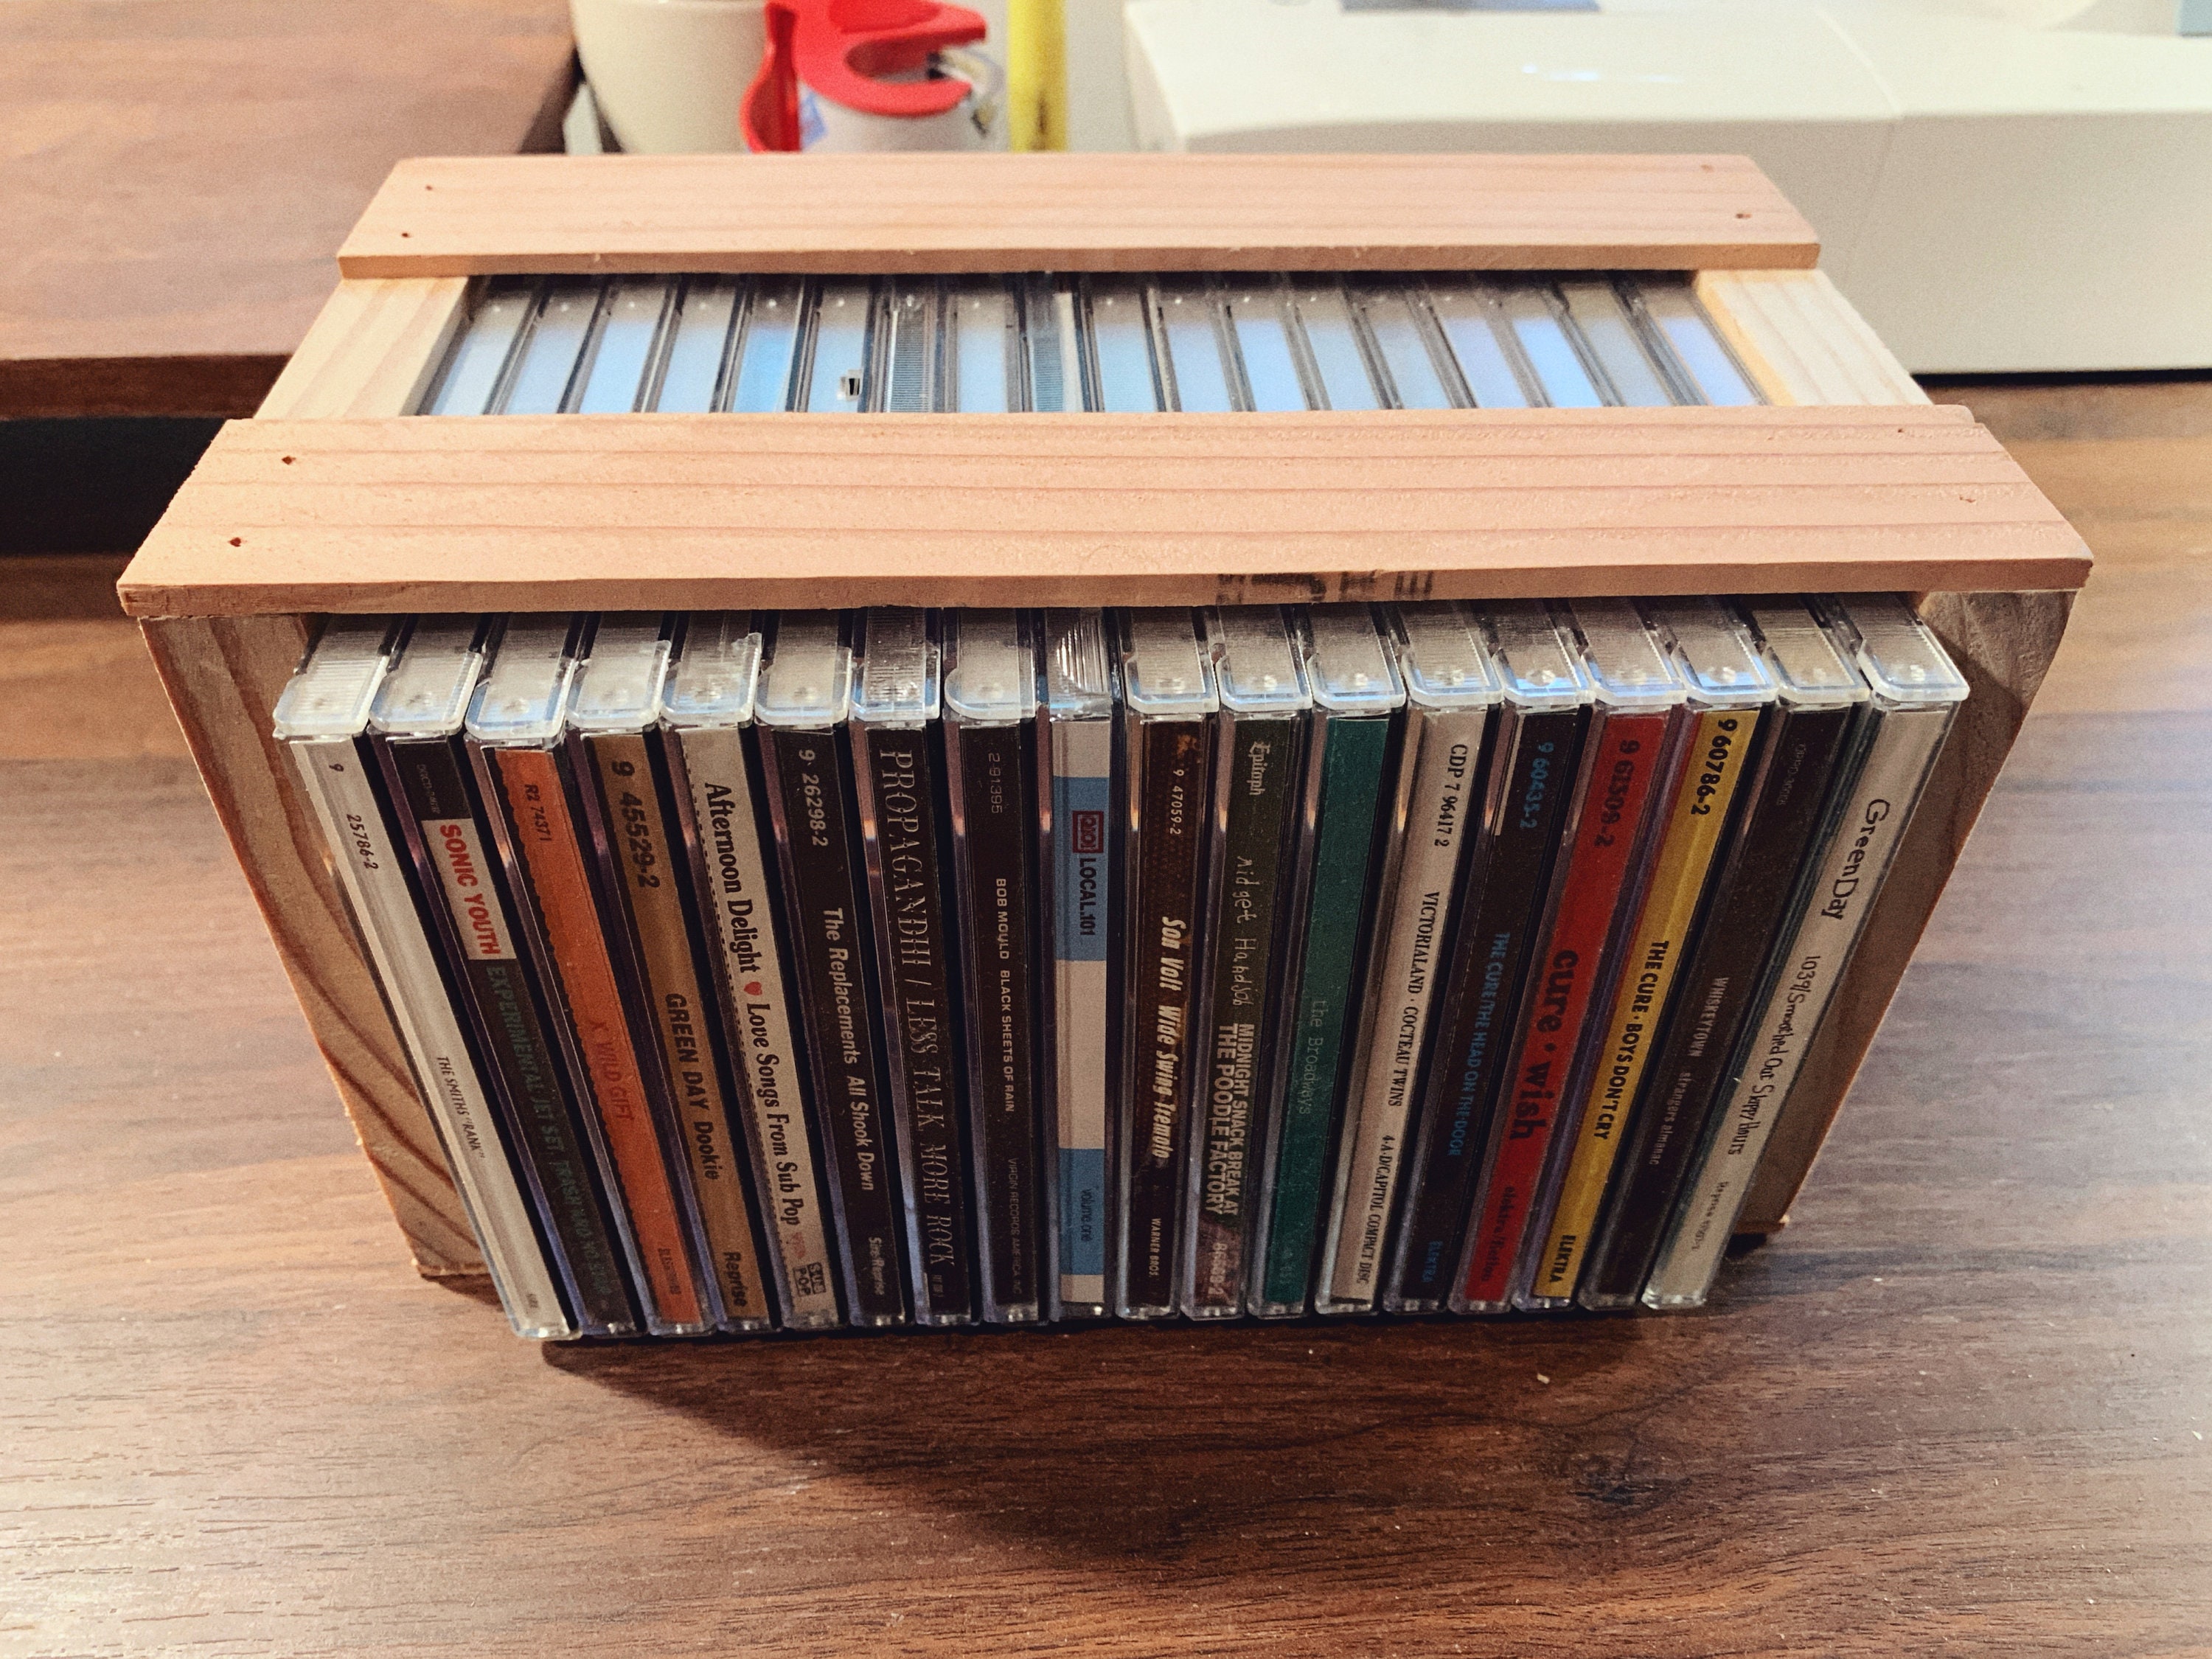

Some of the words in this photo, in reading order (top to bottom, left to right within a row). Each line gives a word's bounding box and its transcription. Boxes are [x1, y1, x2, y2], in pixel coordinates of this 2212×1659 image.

[1717, 718, 1738, 731] 9
[1447, 743, 1467, 779] CDP
[1536, 741, 1554, 753] 9
[1618, 739, 1641, 754] 9
[610, 759, 635, 776] 9
[1172, 768, 1185, 776] 9
[1246, 740, 1271, 796] Epitaph
[1443, 782, 1461, 791] 7
[1689, 734, 1731, 815] 60786-2
[524, 783, 540, 801] R2
[801, 773, 829, 846] 26298-2
[1168, 785, 1183, 835] 47059-2
[1518, 757, 1550, 829] 60435-2
[327, 762, 345, 772] 9
[345, 813, 379, 869] 25786-2
[529, 805, 552, 841] 74371
[1436, 795, 1458, 835] 96417
[618, 790, 661, 888] 45529-2
[703, 782, 742, 894] Afternoon
[879, 751, 932, 966] PROPAGANDHI
[1433, 838, 1450, 847] 2
[439, 824, 479, 887] SONIC
[463, 892, 501, 955] YOUTH
[995, 877, 1008, 907] BOB
[726, 898, 762, 973] Delight
[823, 907, 844, 941] The
[995, 910, 1010, 959] MOULD
[1161, 916, 1186, 950] Son
[1407, 891, 1440, 994] VICTORIALAND
[1489, 932, 1511, 959] THE
[1644, 940, 1669, 970] THE
[999, 969, 1012, 1012] BLACK
[1158, 956, 1184, 991] Volt
[1536, 948, 1579, 1033] cure
[1630, 972, 1658, 1012] CURE
[828, 947, 861, 1064] Replacements
[1308, 999, 1329, 1028] the
[1474, 961, 1503, 1028] CURE/THE
[585, 1017, 610, 1032] X
[664, 992, 699, 1062] GREEN
[745, 1002, 771, 1048] Love
[905, 999, 938, 1054] LESS
[1156, 1004, 1182, 1045] Wide
[1394, 1006, 1419, 1065] COCTEAU
[1688, 976, 1730, 1057] WHISKEYTOWN
[485, 965, 545, 1092] EXPERIMENTAL
[529, 1096, 555, 1120] JET
[1001, 1015, 1014, 1062] SHEETS
[1217, 1022, 1241, 1060] THE
[1466, 1031, 1488, 1068] HEAD
[1615, 1023, 1644, 1062] BOYS
[435, 1056, 454, 1075] THE
[592, 1040, 627, 1083] WILD
[754, 1052, 780, 1107] Songs
[1002, 1065, 1014, 1081] OF
[1152, 1049, 1179, 1096] Swing
[1229, 1022, 1255, 1098] MIDNIGHT
[1295, 1036, 1324, 1114] Broadways
[1758, 1057, 1784, 1080] Out
[444, 1077, 470, 1116] SMITHS
[680, 1071, 709, 1110] DAY
[846, 1075, 867, 1096] All
[1004, 1084, 1015, 1112] RAIN
[1208, 1063, 1238, 1136] POODLE
[1387, 1067, 1408, 1107] TWINS
[1460, 1070, 1480, 1092] ON
[1507, 1060, 1554, 1141] wish
[1601, 1065, 1630, 1111] DON'T
[1663, 1071, 1694, 1123] strangers
[606, 1084, 635, 1122] GIFT
[1738, 1084, 1775, 1121] Slappy
[765, 1113, 790, 1156] From
[849, 1101, 873, 1147] Shook
[1151, 1101, 1176, 1158] Tremolo
[1225, 1098, 1248, 1150] SNACK
[1447, 1119, 1468, 1155] DOOR
[1593, 1113, 1615, 1140] CRY
[1648, 1124, 1674, 1165] almanac
[1726, 1120, 1761, 1155] Hours
[692, 1120, 723, 1180] Dookie
[775, 1161, 801, 1193] Sub
[856, 1151, 875, 1191] Down
[919, 1142, 950, 1204] MORE
[1006, 1157, 1019, 1189] VIRGIN
[1205, 1140, 1231, 1214] FACTORY
[1221, 1150, 1243, 1197] BREAK
[778, 1197, 804, 1225] Pop
[1008, 1191, 1020, 1235] RECORDS
[1079, 1188, 1096, 1223] volume
[1220, 1197, 1238, 1215] AT
[925, 1214, 955, 1265] ROCK
[1079, 1222, 1093, 1242] one
[1149, 1217, 1161, 1253] WARNER
[1360, 1213, 1382, 1260] COMPACT
[722, 1251, 748, 1307] Reprise
[1355, 1261, 1373, 1284] DISC
[1548, 1234, 1576, 1284] ELEKTRA
